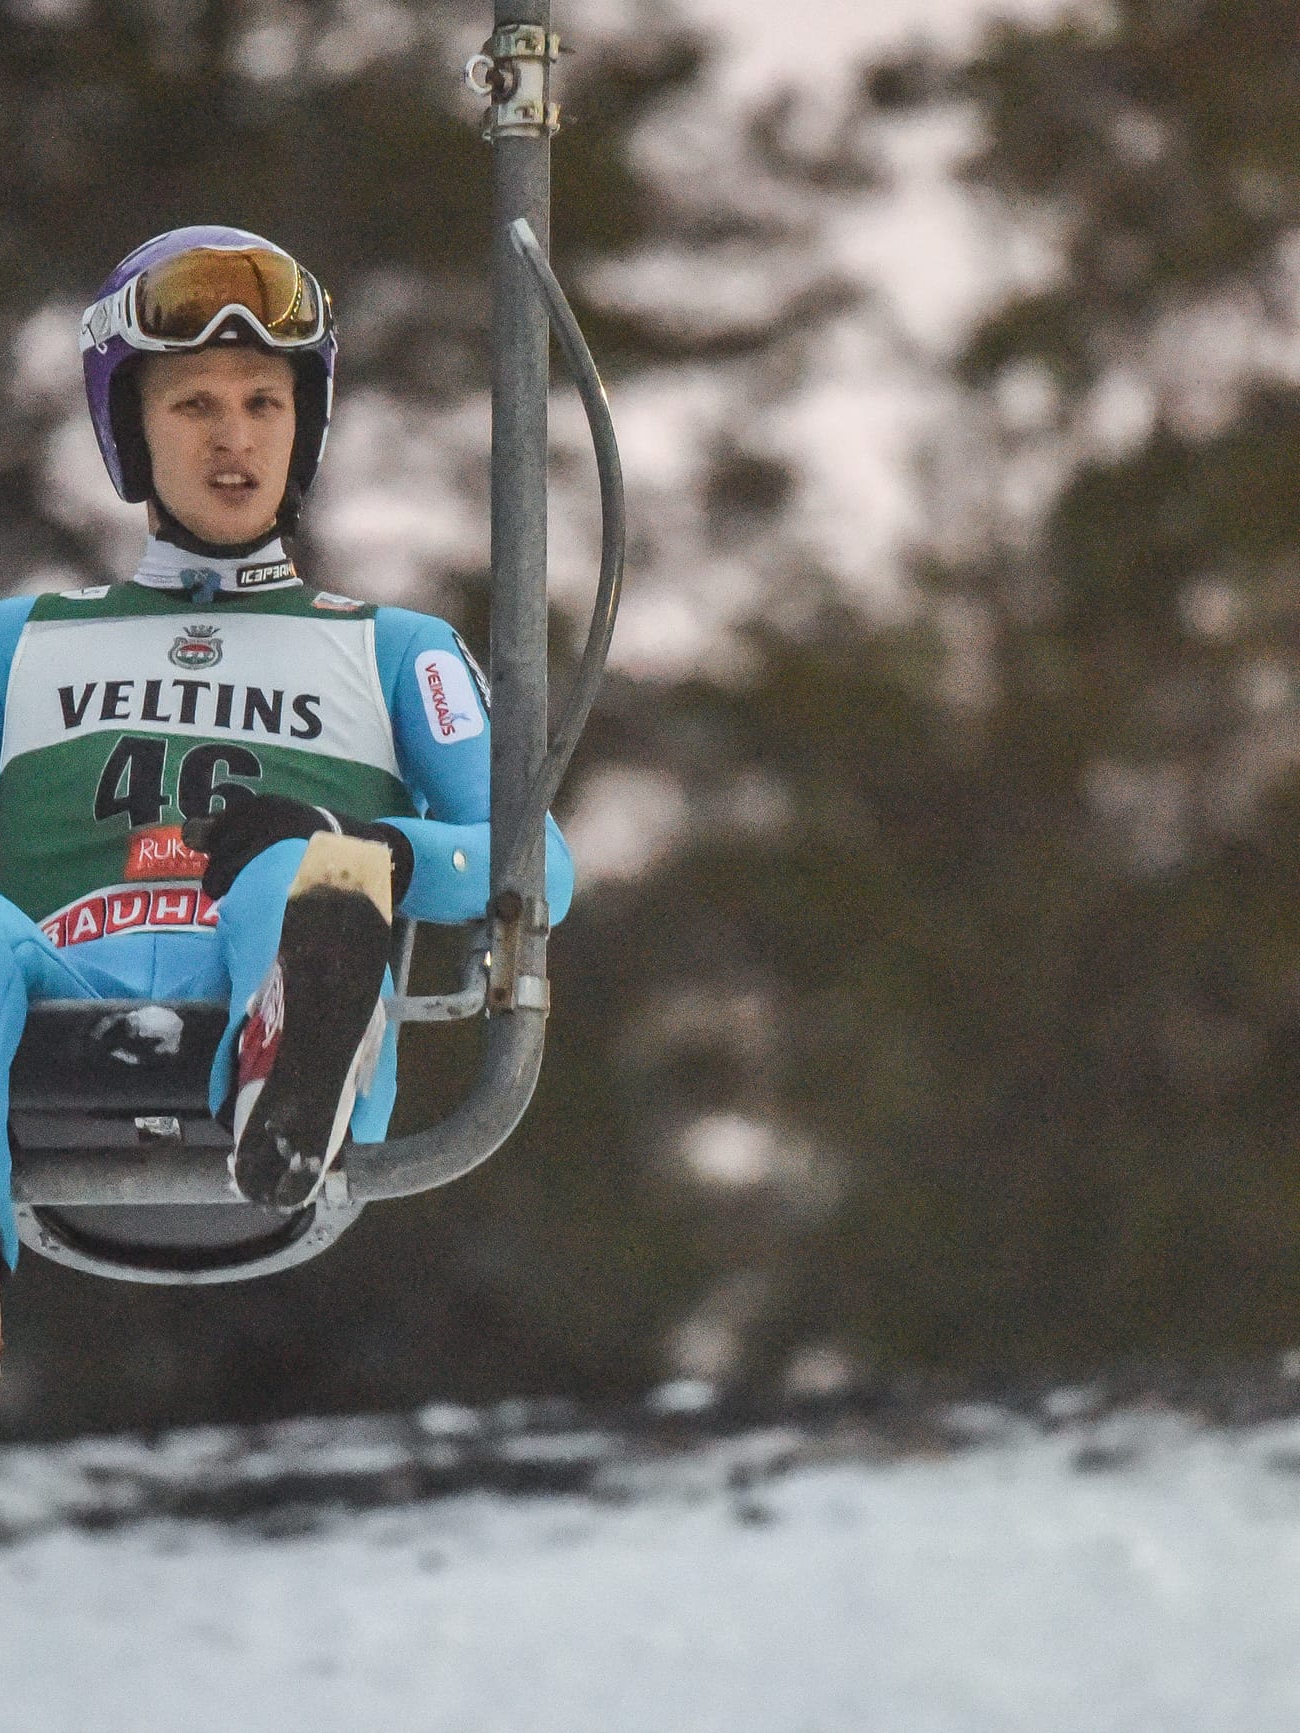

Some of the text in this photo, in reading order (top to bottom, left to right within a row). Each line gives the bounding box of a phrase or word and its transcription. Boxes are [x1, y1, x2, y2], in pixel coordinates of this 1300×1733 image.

[58, 679, 323, 739] VELTINS
[425, 663, 456, 736] VEIKKAUS
[93, 734, 263, 830] 46
